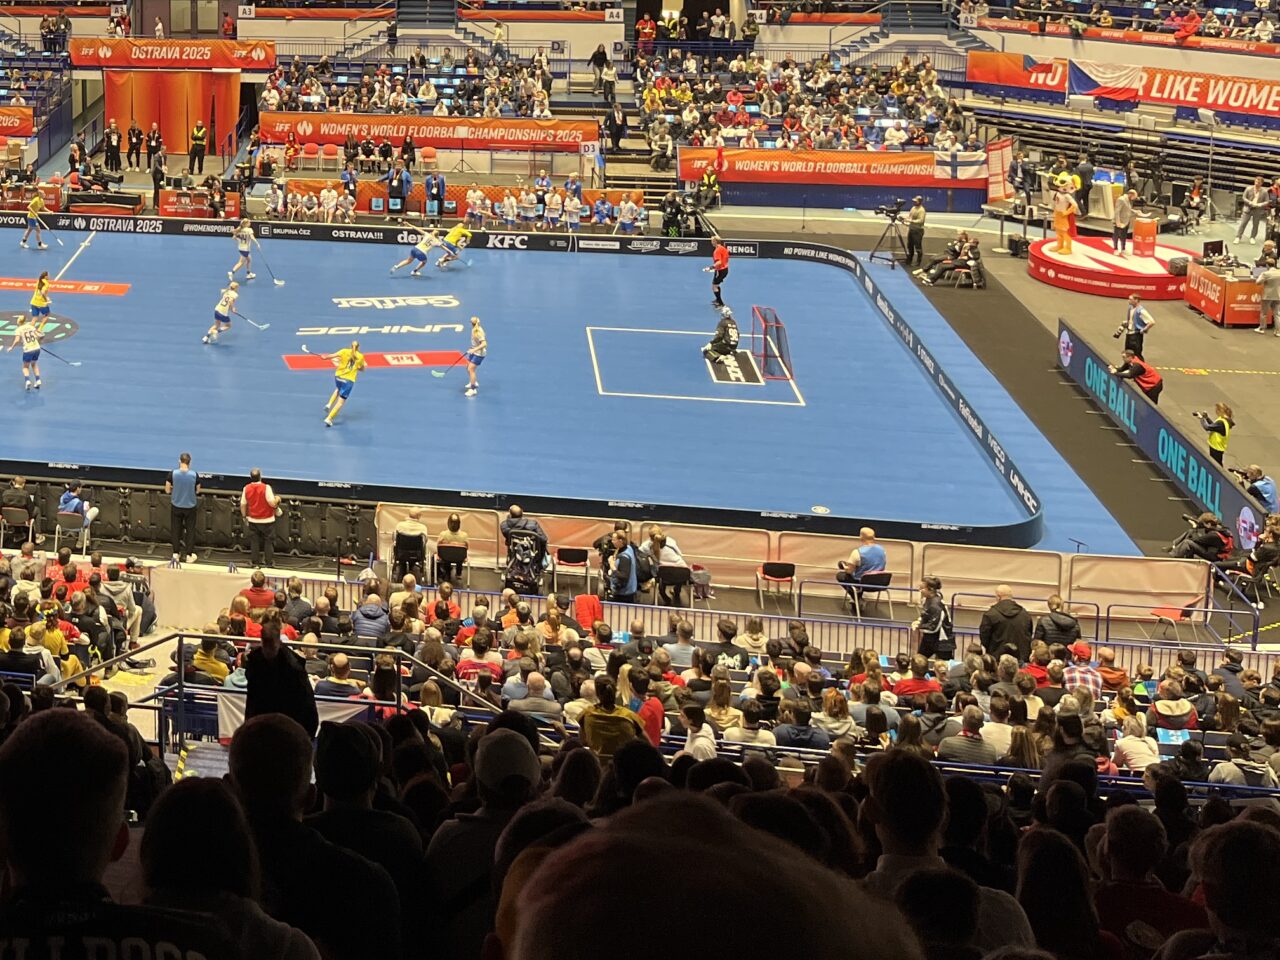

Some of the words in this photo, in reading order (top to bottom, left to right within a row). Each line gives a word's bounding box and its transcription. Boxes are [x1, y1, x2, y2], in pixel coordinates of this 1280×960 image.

[241, 6, 253, 16] A3
[608, 11, 621, 20] A4
[963, 15, 974, 24] A5
[131, 46, 180, 59] OSTRAVA
[182, 46, 211, 60] 2025
[1150, 69, 1207, 103] LIKE
[1208, 77, 1280, 111] WOME
[319, 122, 369, 137] WOMEN'S
[370, 124, 407, 138] WORLD
[408, 125, 459, 138] FLOORBA
[469, 126, 555, 142] CHAMPIONSHIPS
[556, 129, 583, 142] 2025
[582, 144, 596, 155] D3
[735, 160, 780, 173] WOMEN'S
[781, 161, 813, 174] WORLD
[815, 161, 868, 174] FLOORBALL
[870, 162, 935, 176] CHAMPIONSH
[89, 217, 134, 232] OSTRAVA
[135, 219, 163, 233] 2025
[272, 228, 298, 236] SKUPINA
[299, 227, 311, 236] ČEZ
[332, 229, 383, 240] OSTRAVA!!!
[486, 234, 528, 249] KFC
[727, 245, 755, 254] RENGL
[794, 248, 815, 257] POWER
[816, 250, 828, 260] LIKE
[1190, 270, 1200, 294] DJ
[1199, 276, 1222, 304] STAGE
[332, 295, 460, 309] Gerflor
[296, 324, 464, 335] UNIHOC
[1084, 356, 1107, 402] ONE
[1108, 381, 1138, 435] BALL
[1157, 428, 1187, 482] ONE
[1188, 455, 1223, 520] BALL
[1009, 469, 1038, 514] UNIHOC
